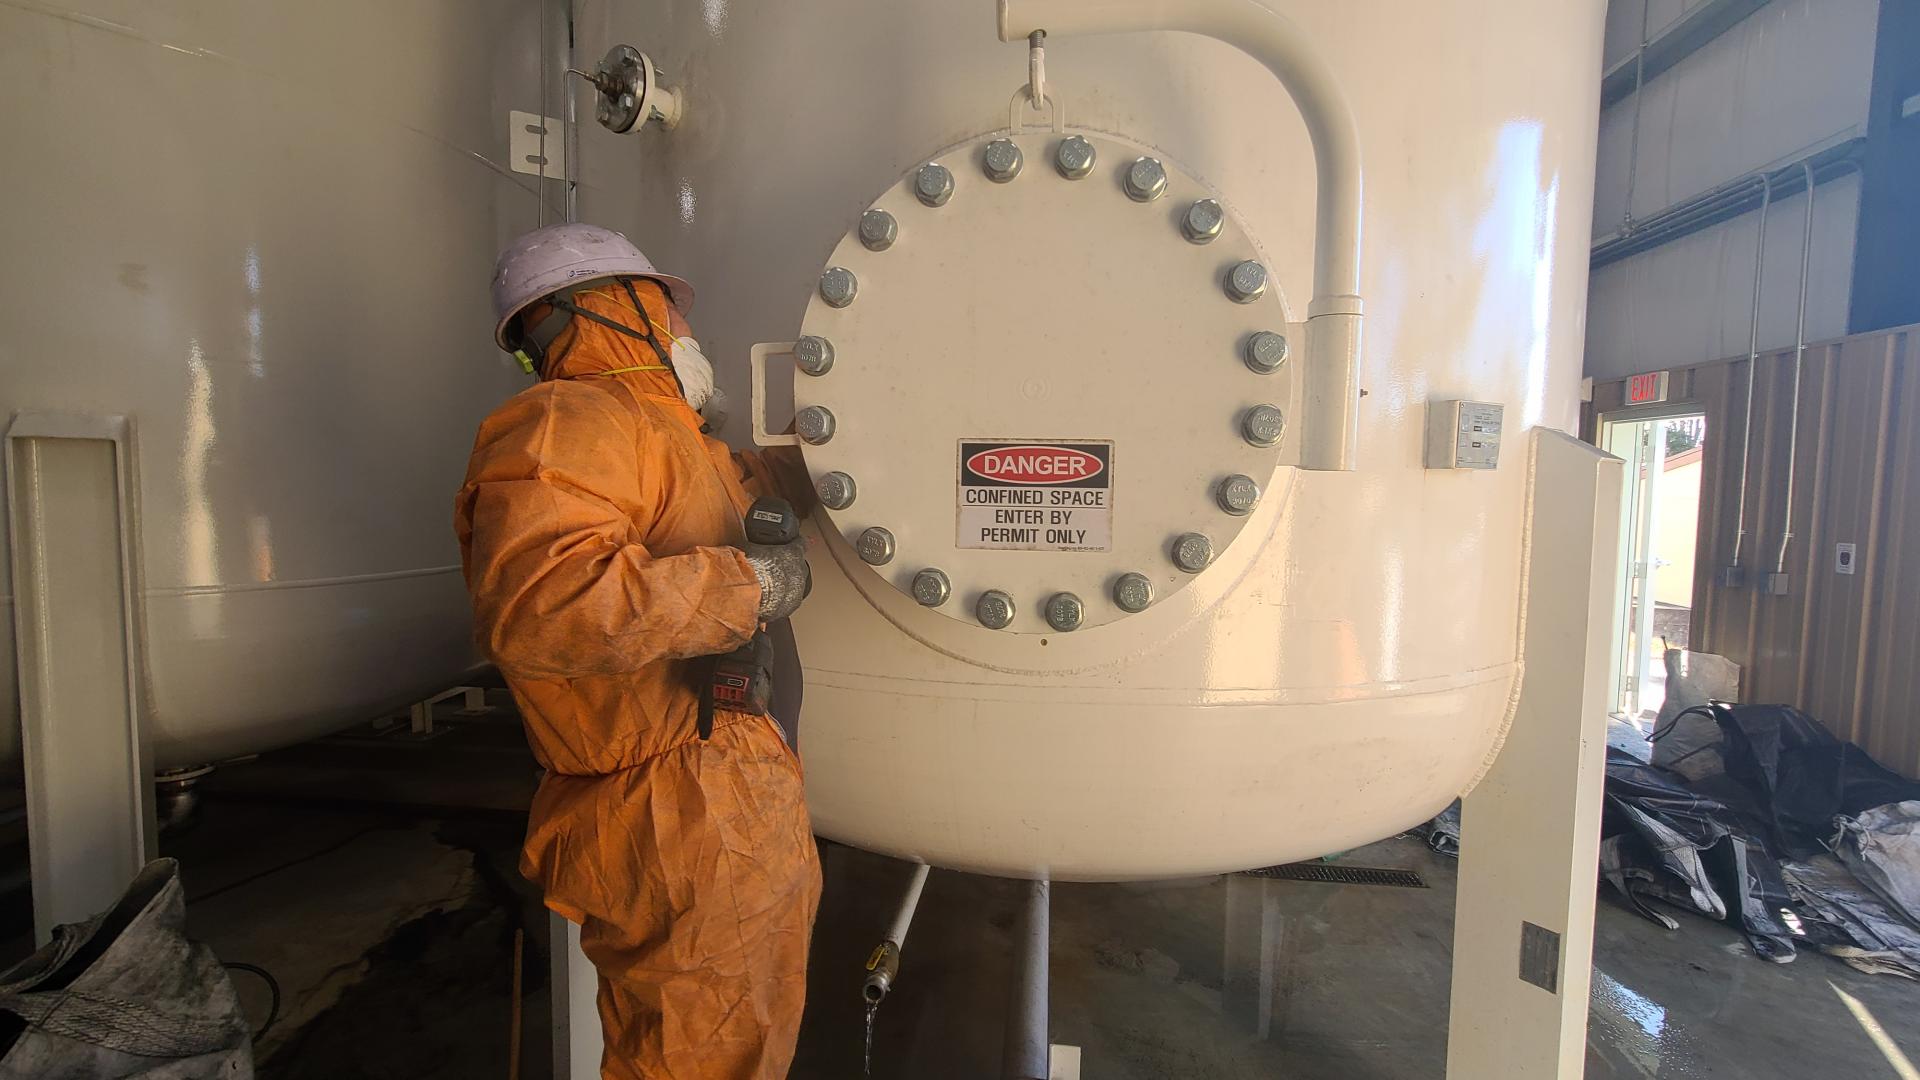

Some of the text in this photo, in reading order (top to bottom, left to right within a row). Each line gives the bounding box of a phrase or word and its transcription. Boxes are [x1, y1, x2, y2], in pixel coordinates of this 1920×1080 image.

[1631, 373, 1657, 401] EXIT
[984, 455, 1087, 476] DANGER
[965, 489, 1104, 506] CONFINED SPACE
[995, 509, 1073, 525] ENTER BY
[981, 527, 1087, 544] PERMIT ONLY
